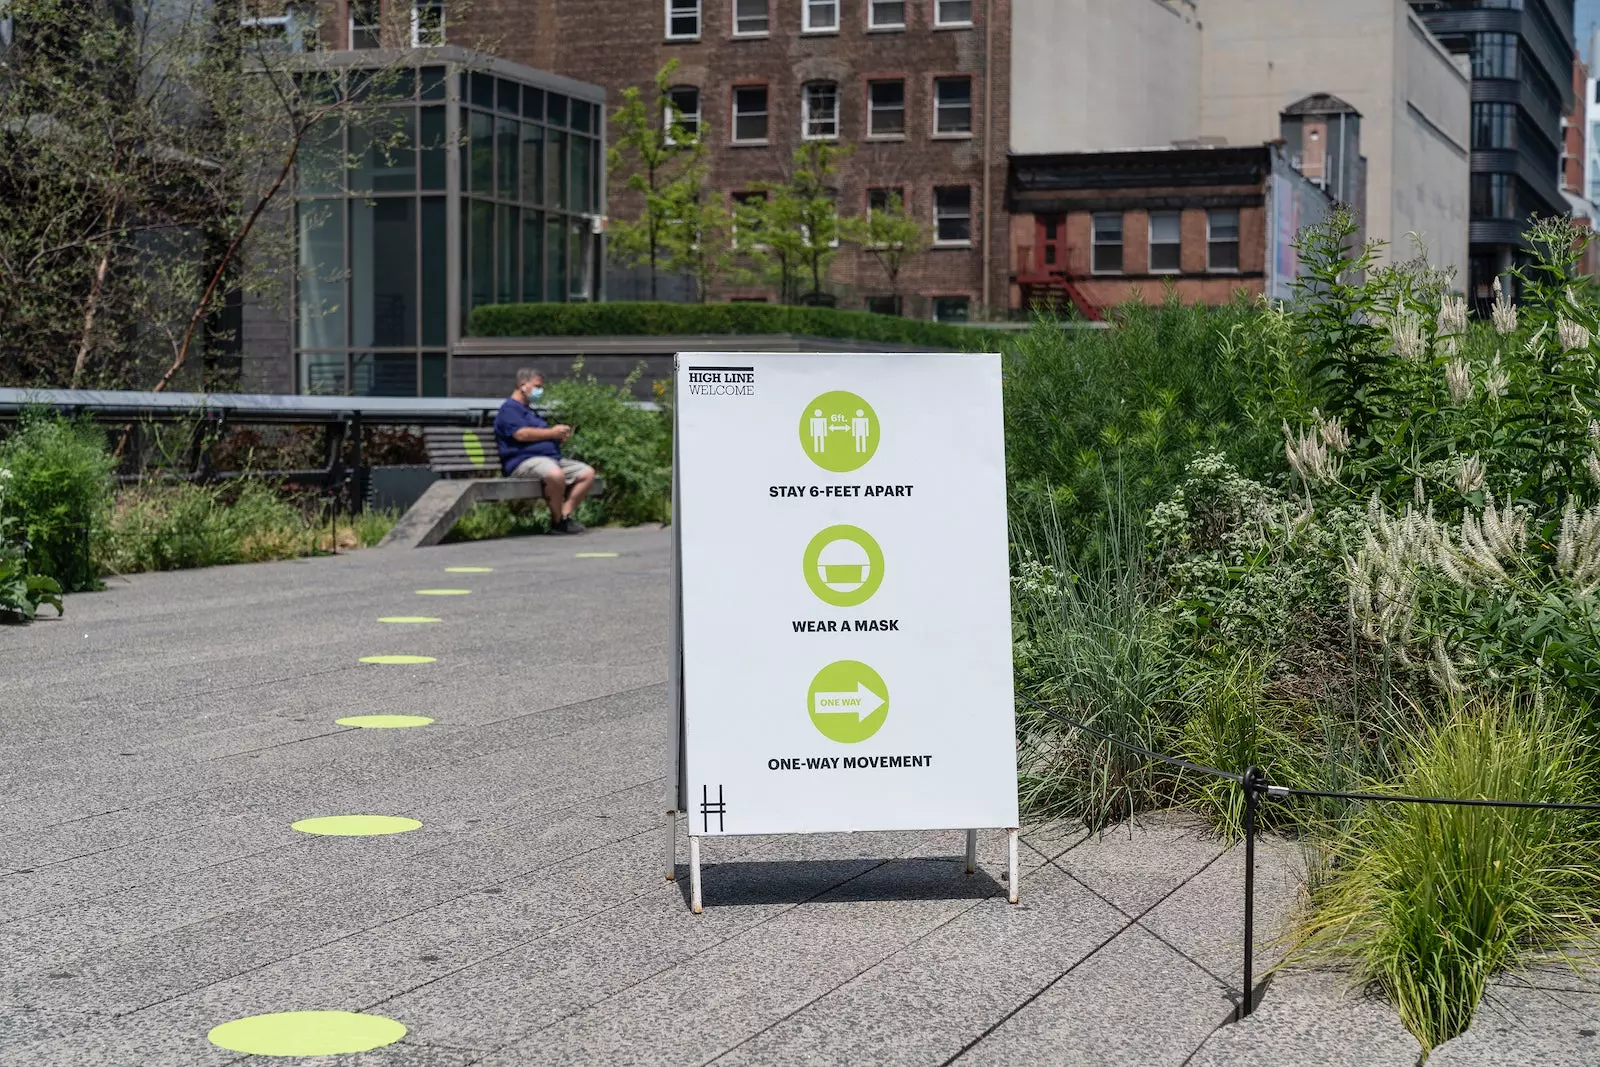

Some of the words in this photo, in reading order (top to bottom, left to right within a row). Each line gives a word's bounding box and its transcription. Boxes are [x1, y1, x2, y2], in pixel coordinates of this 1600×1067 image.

[689, 373, 721, 383] HIGH
[724, 373, 754, 383] LINE
[689, 385, 754, 395] WELCOME
[831, 414, 848, 423] 6ft.
[769, 486, 806, 498] STAY
[809, 485, 861, 498] 6-FEET
[864, 485, 914, 497] APART
[792, 620, 837, 633] WEAR
[840, 620, 852, 632] A
[854, 619, 900, 632] MASK
[820, 698, 840, 707] ONE
[842, 698, 862, 706] WAY
[767, 757, 840, 771] ONE-WAY
[843, 755, 933, 769] MOVEMENT
